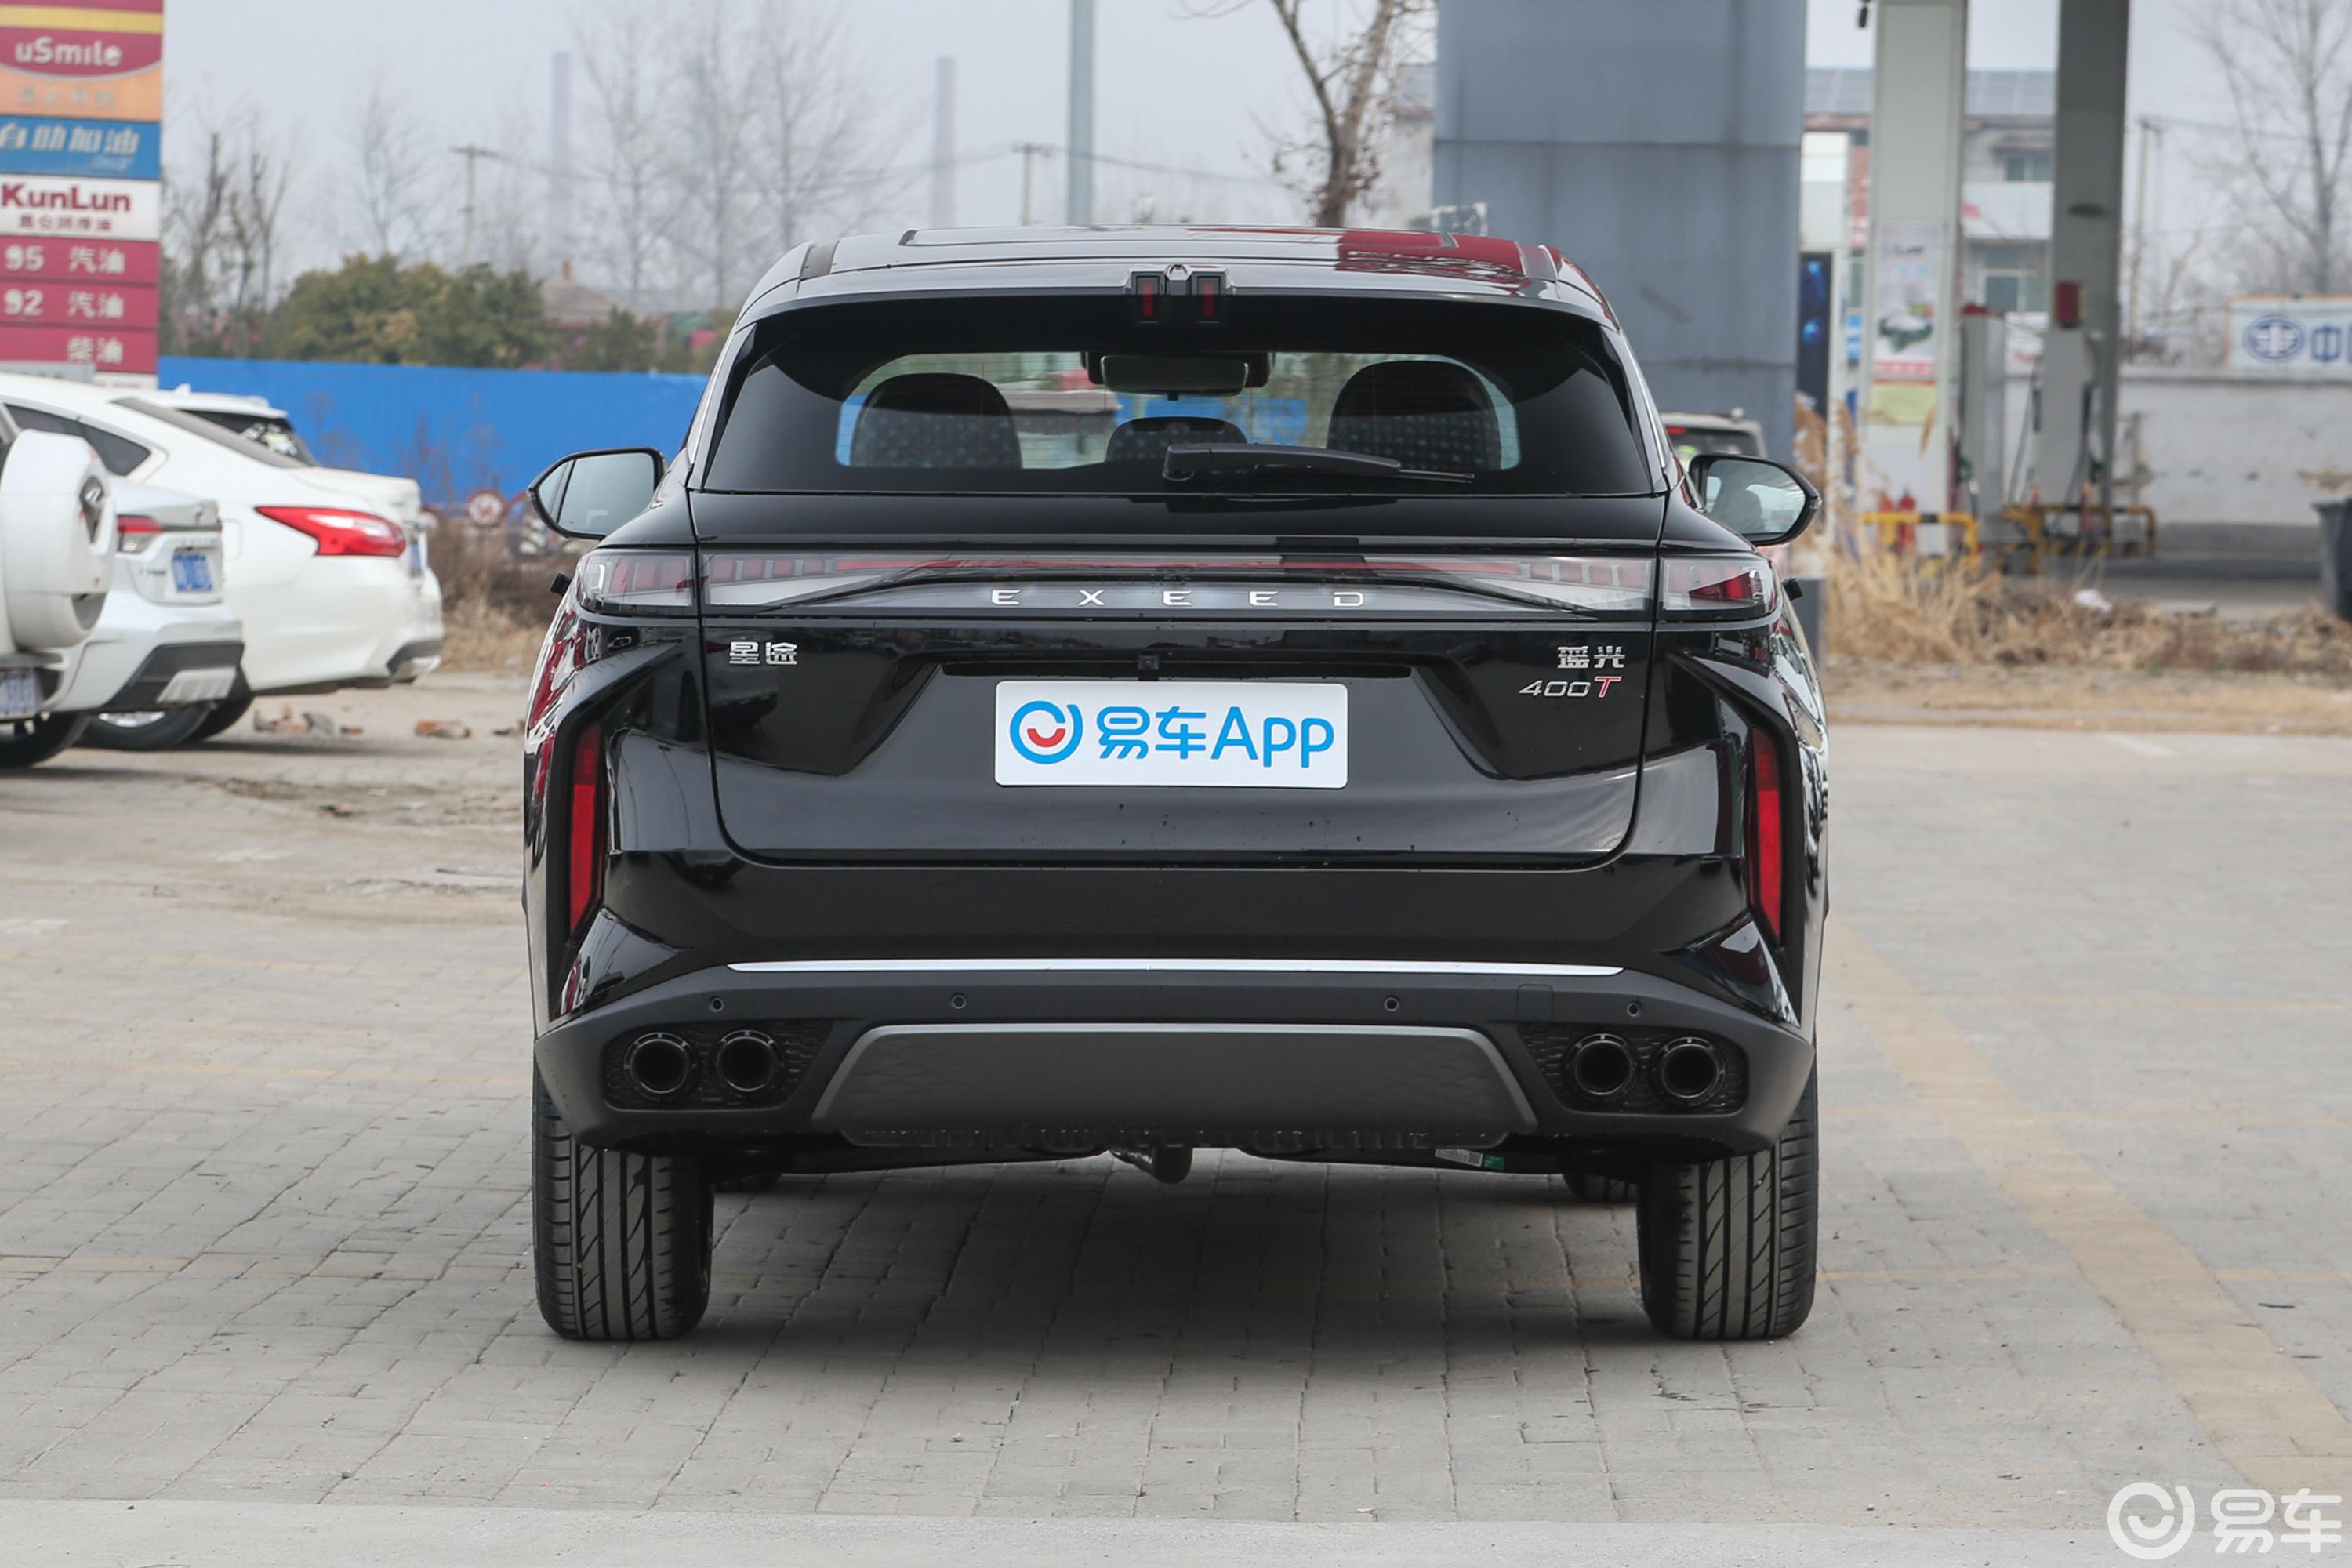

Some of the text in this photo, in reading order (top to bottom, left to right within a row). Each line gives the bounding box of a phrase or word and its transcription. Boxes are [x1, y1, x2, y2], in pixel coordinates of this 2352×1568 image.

[15, 36, 123, 67] uSmile
[2, 183, 131, 211] KunLun
[5, 244, 45, 271] 95
[4, 289, 43, 315] 92
[2310, 321, 2352, 365] 中
[990, 589, 1366, 608] EXEED
[729, 641, 797, 665] 星途
[1557, 645, 1625, 669] 瑶光
[1097, 706, 1334, 768] 易车App
